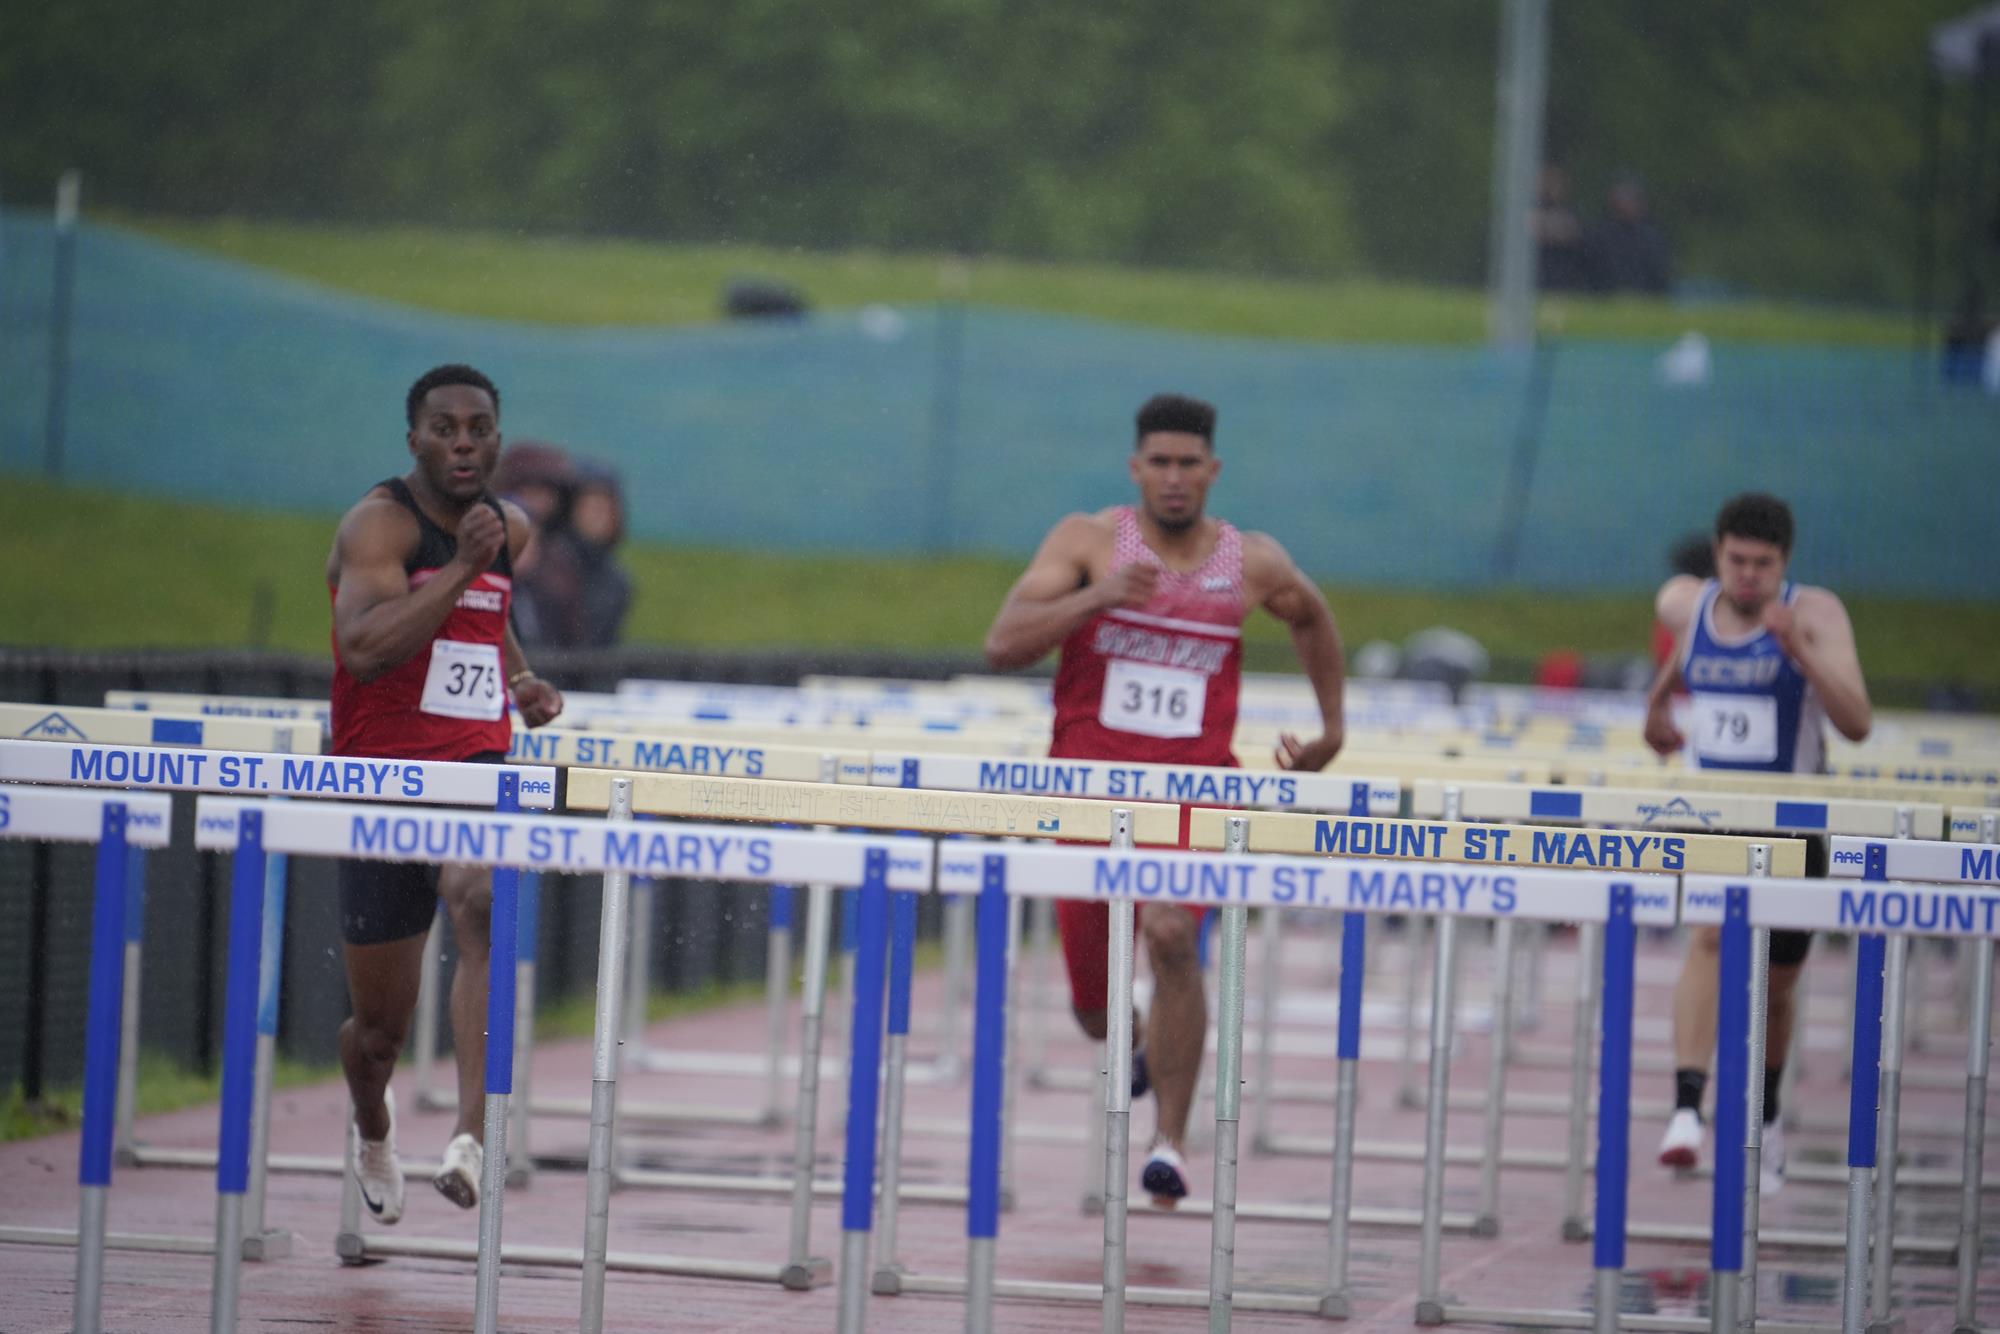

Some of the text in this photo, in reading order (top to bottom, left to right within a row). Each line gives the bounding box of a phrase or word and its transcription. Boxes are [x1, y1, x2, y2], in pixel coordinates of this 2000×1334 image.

[446, 663, 495, 699] 375
[1121, 680, 1188, 720] 316
[1714, 709, 1750, 744] 79
[70, 749, 424, 796] MOUNT ST. MARY'S
[576, 737, 619, 766] ST.
[634, 741, 765, 775] MARY'S
[979, 762, 1297, 804] MOUNT ST. MARY'S
[351, 816, 772, 874] MOUNT ST. MARY'S
[1315, 820, 1686, 870] MOUNT ST. MARY'S
[1094, 857, 1518, 913] MOUNT ST. MARY'S
[1839, 889, 2000, 932] MOUNT
